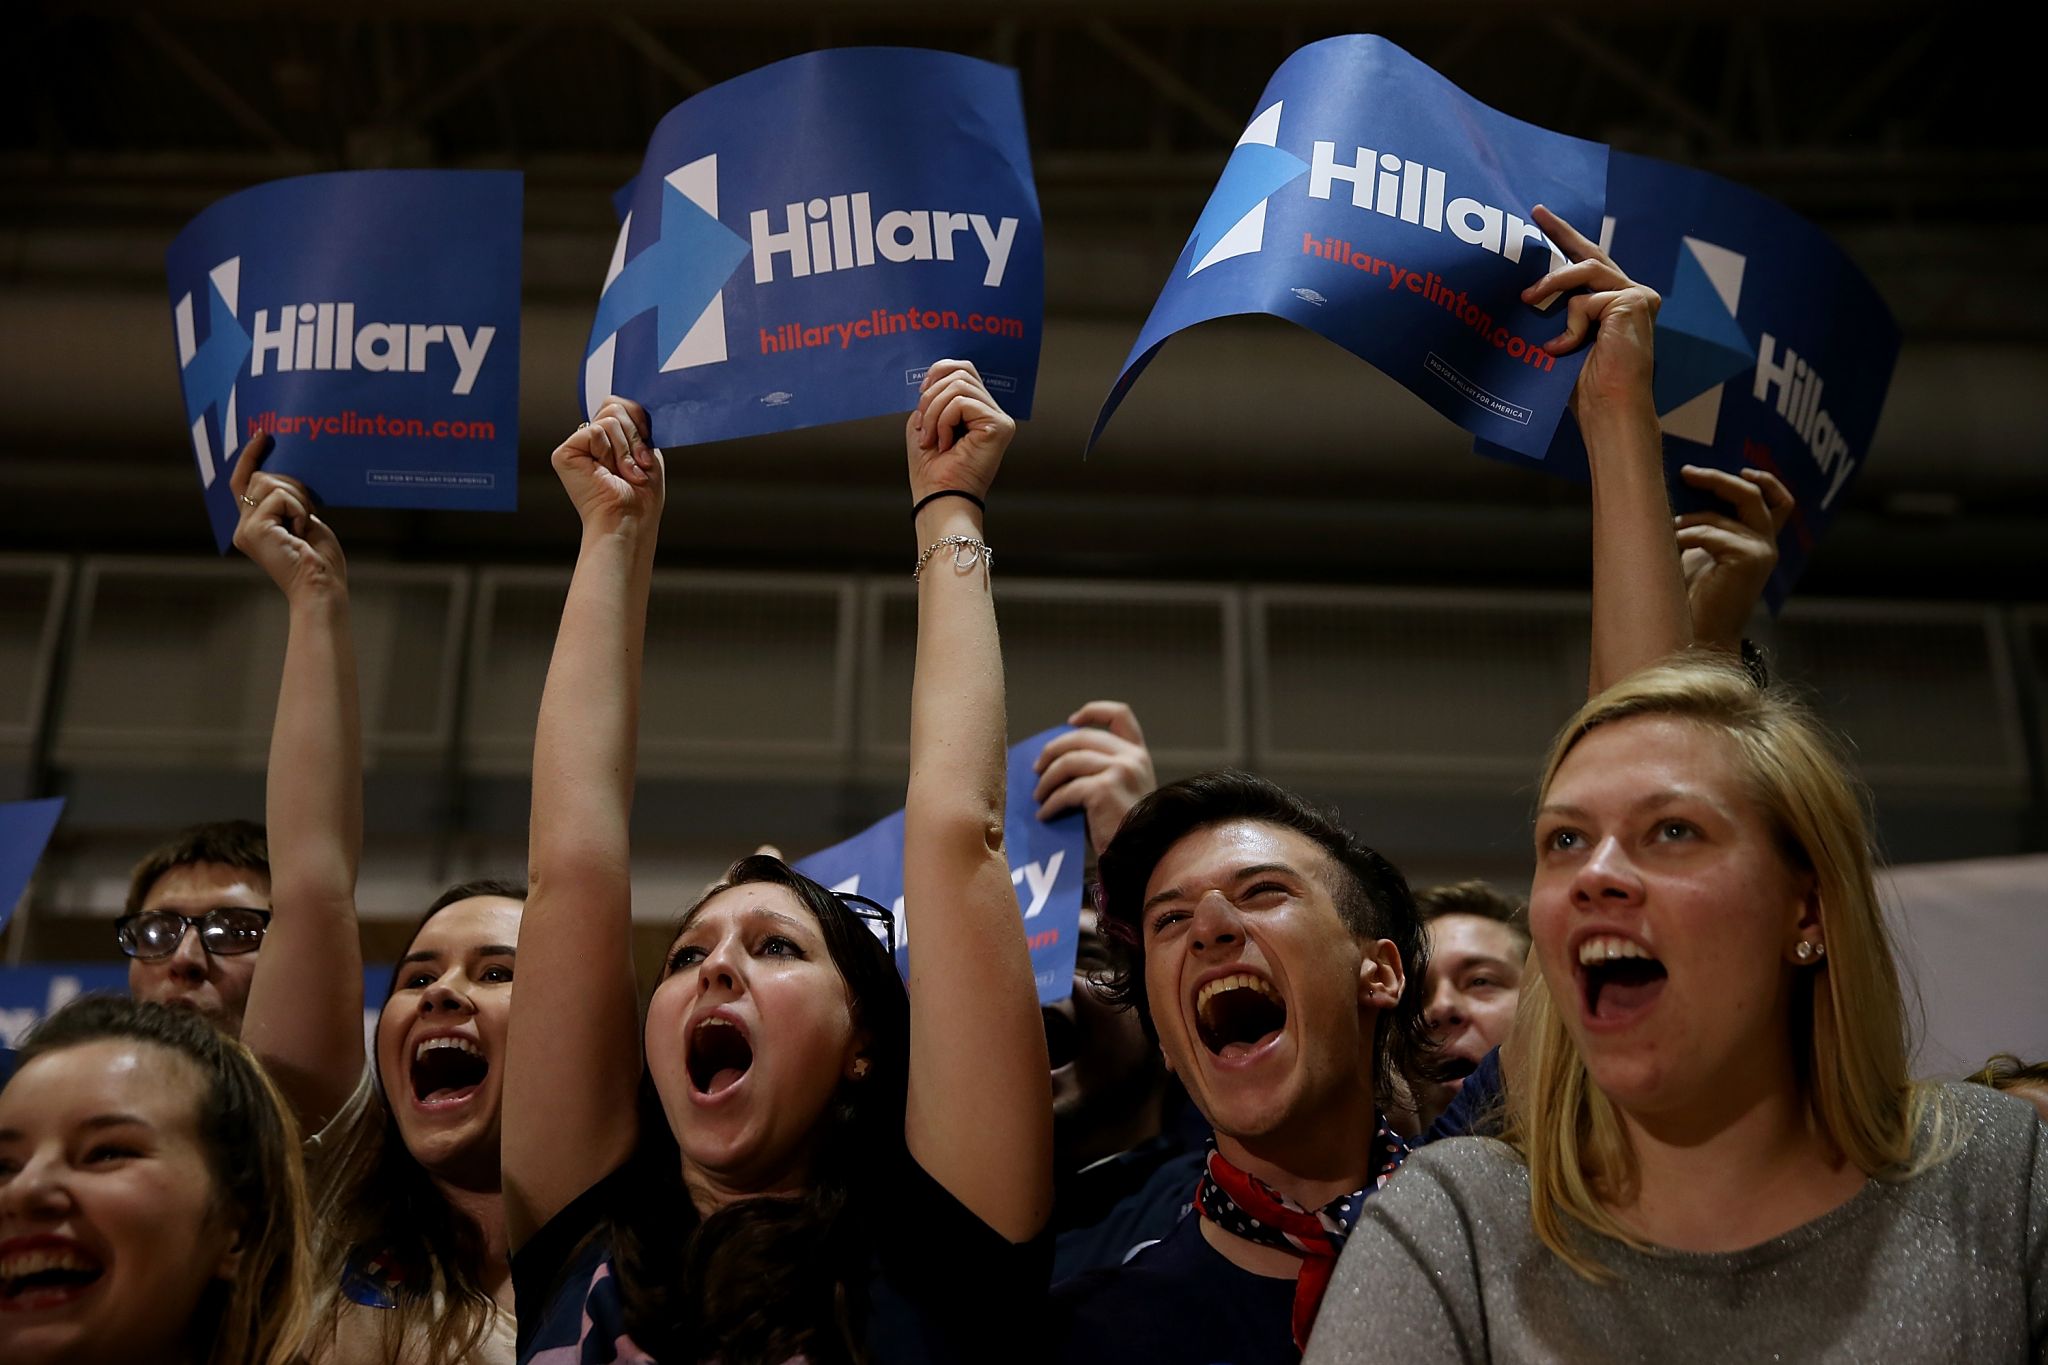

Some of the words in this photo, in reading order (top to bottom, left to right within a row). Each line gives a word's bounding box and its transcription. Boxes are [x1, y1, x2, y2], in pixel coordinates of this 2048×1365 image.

[749, 191, 1019, 287] Hillary
[250, 302, 496, 395] Hillary
[759, 305, 1024, 355] hillaryclinton.com
[1303, 232, 1556, 372] hillaryclinton.com
[247, 411, 496, 440] hillaryclinton.com
[1476, 393, 1490, 404] FOR
[1490, 402, 1523, 418] AMERICA
[1753, 332, 1855, 512] Hillary
